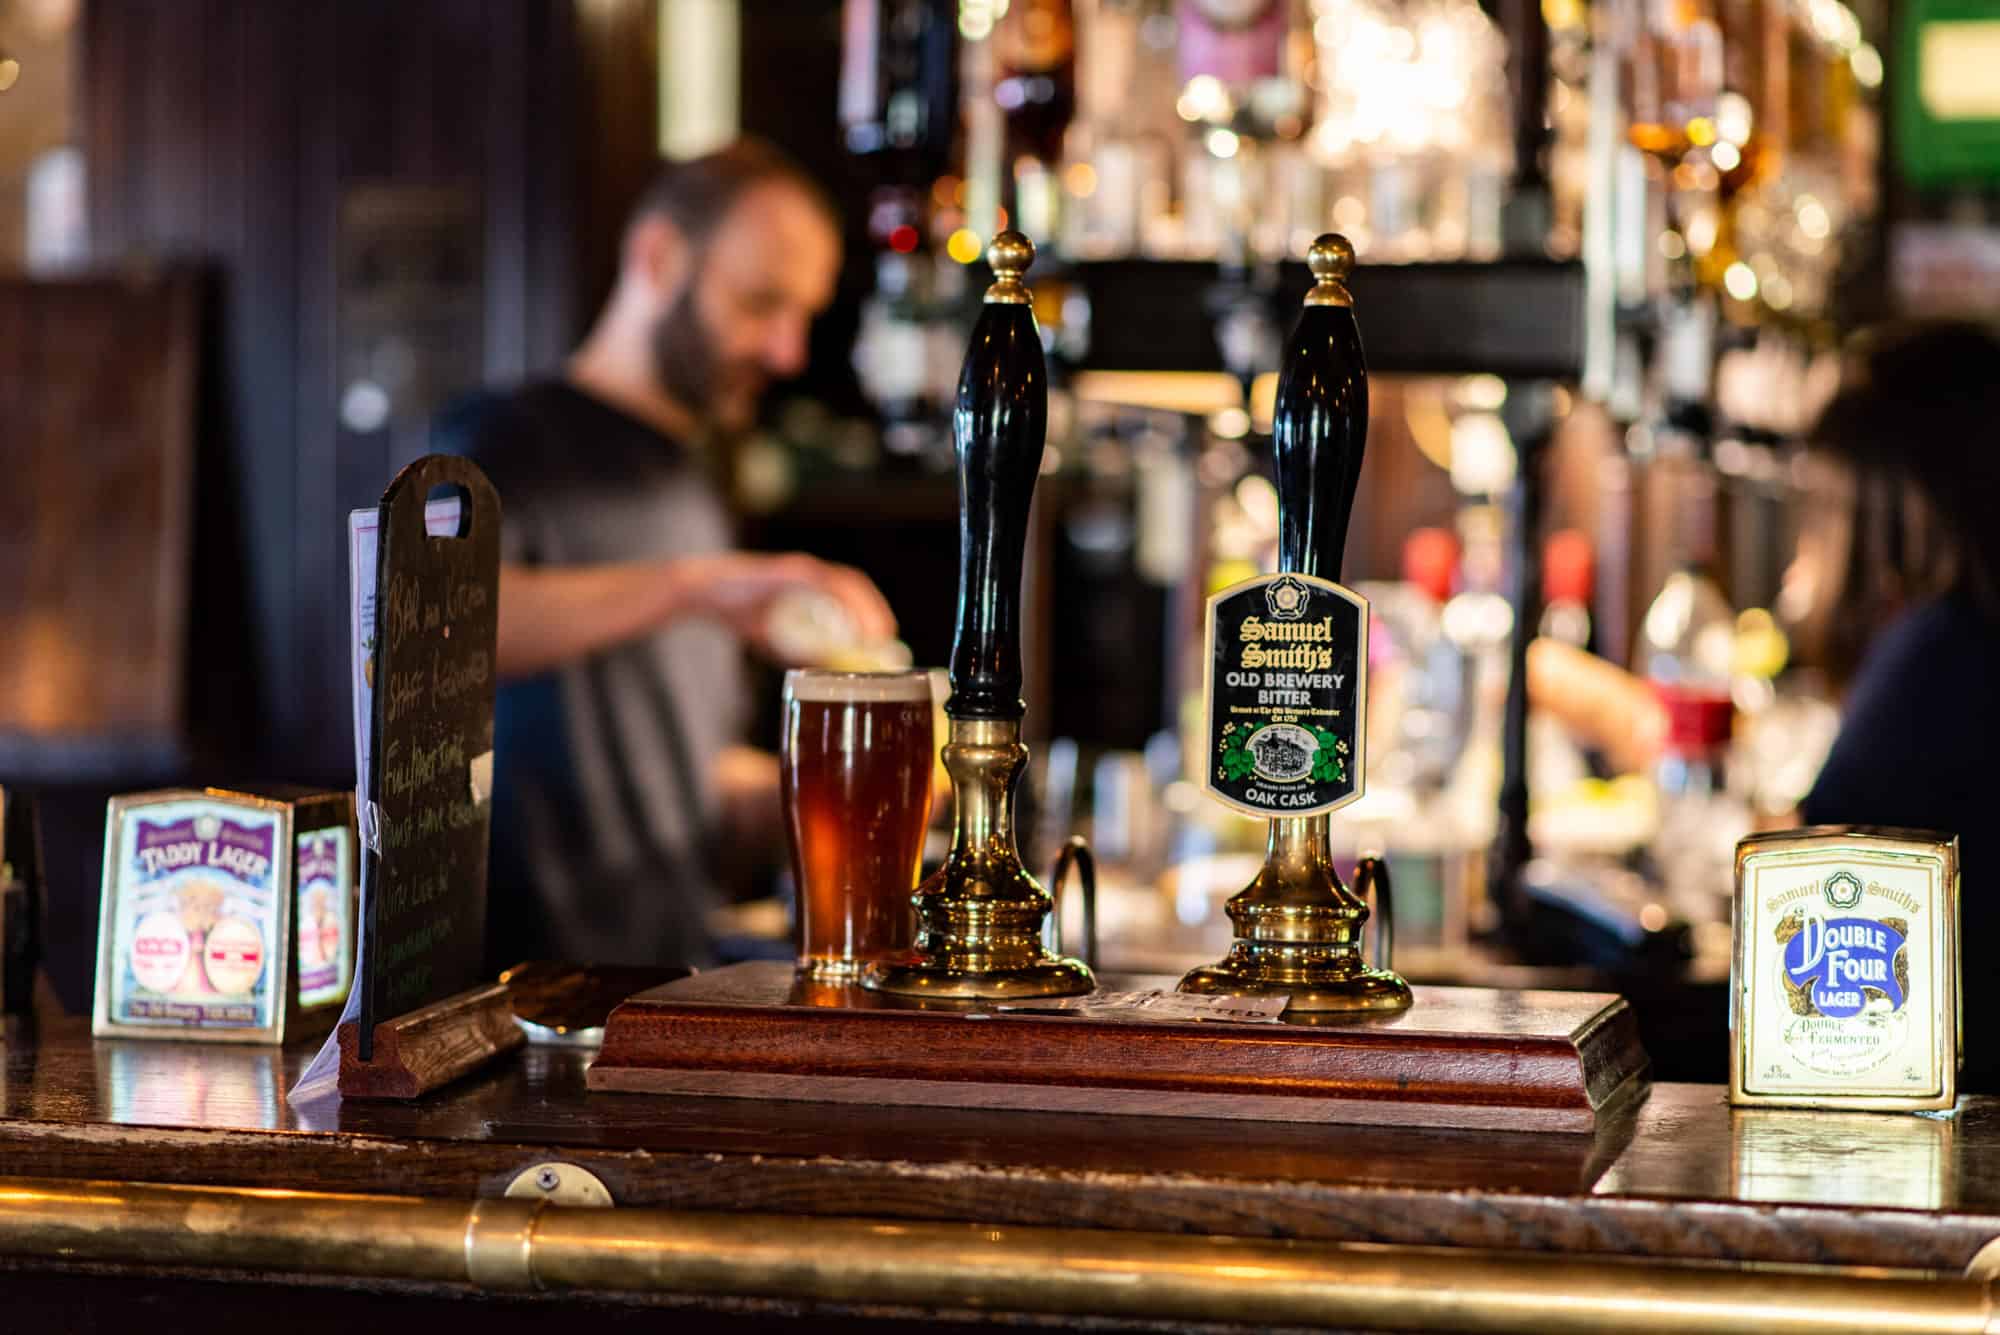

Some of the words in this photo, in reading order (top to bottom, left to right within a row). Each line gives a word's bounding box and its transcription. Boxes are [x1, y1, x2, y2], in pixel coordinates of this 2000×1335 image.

[1240, 616, 1333, 642] Samuel
[1241, 642, 1333, 673] Smith's
[1226, 671, 1260, 687] OLD
[1264, 672, 1344, 689] BREWERY
[1258, 689, 1311, 705] BITTER
[1245, 788, 1276, 805] OAK
[1280, 791, 1317, 806] CASK
[140, 843, 203, 874] TADDY
[207, 841, 268, 876] LAGER
[1790, 912, 1888, 975] DOUBLE
[1825, 949, 1889, 987] FOUR
[1819, 991, 1861, 1007] LAGER
